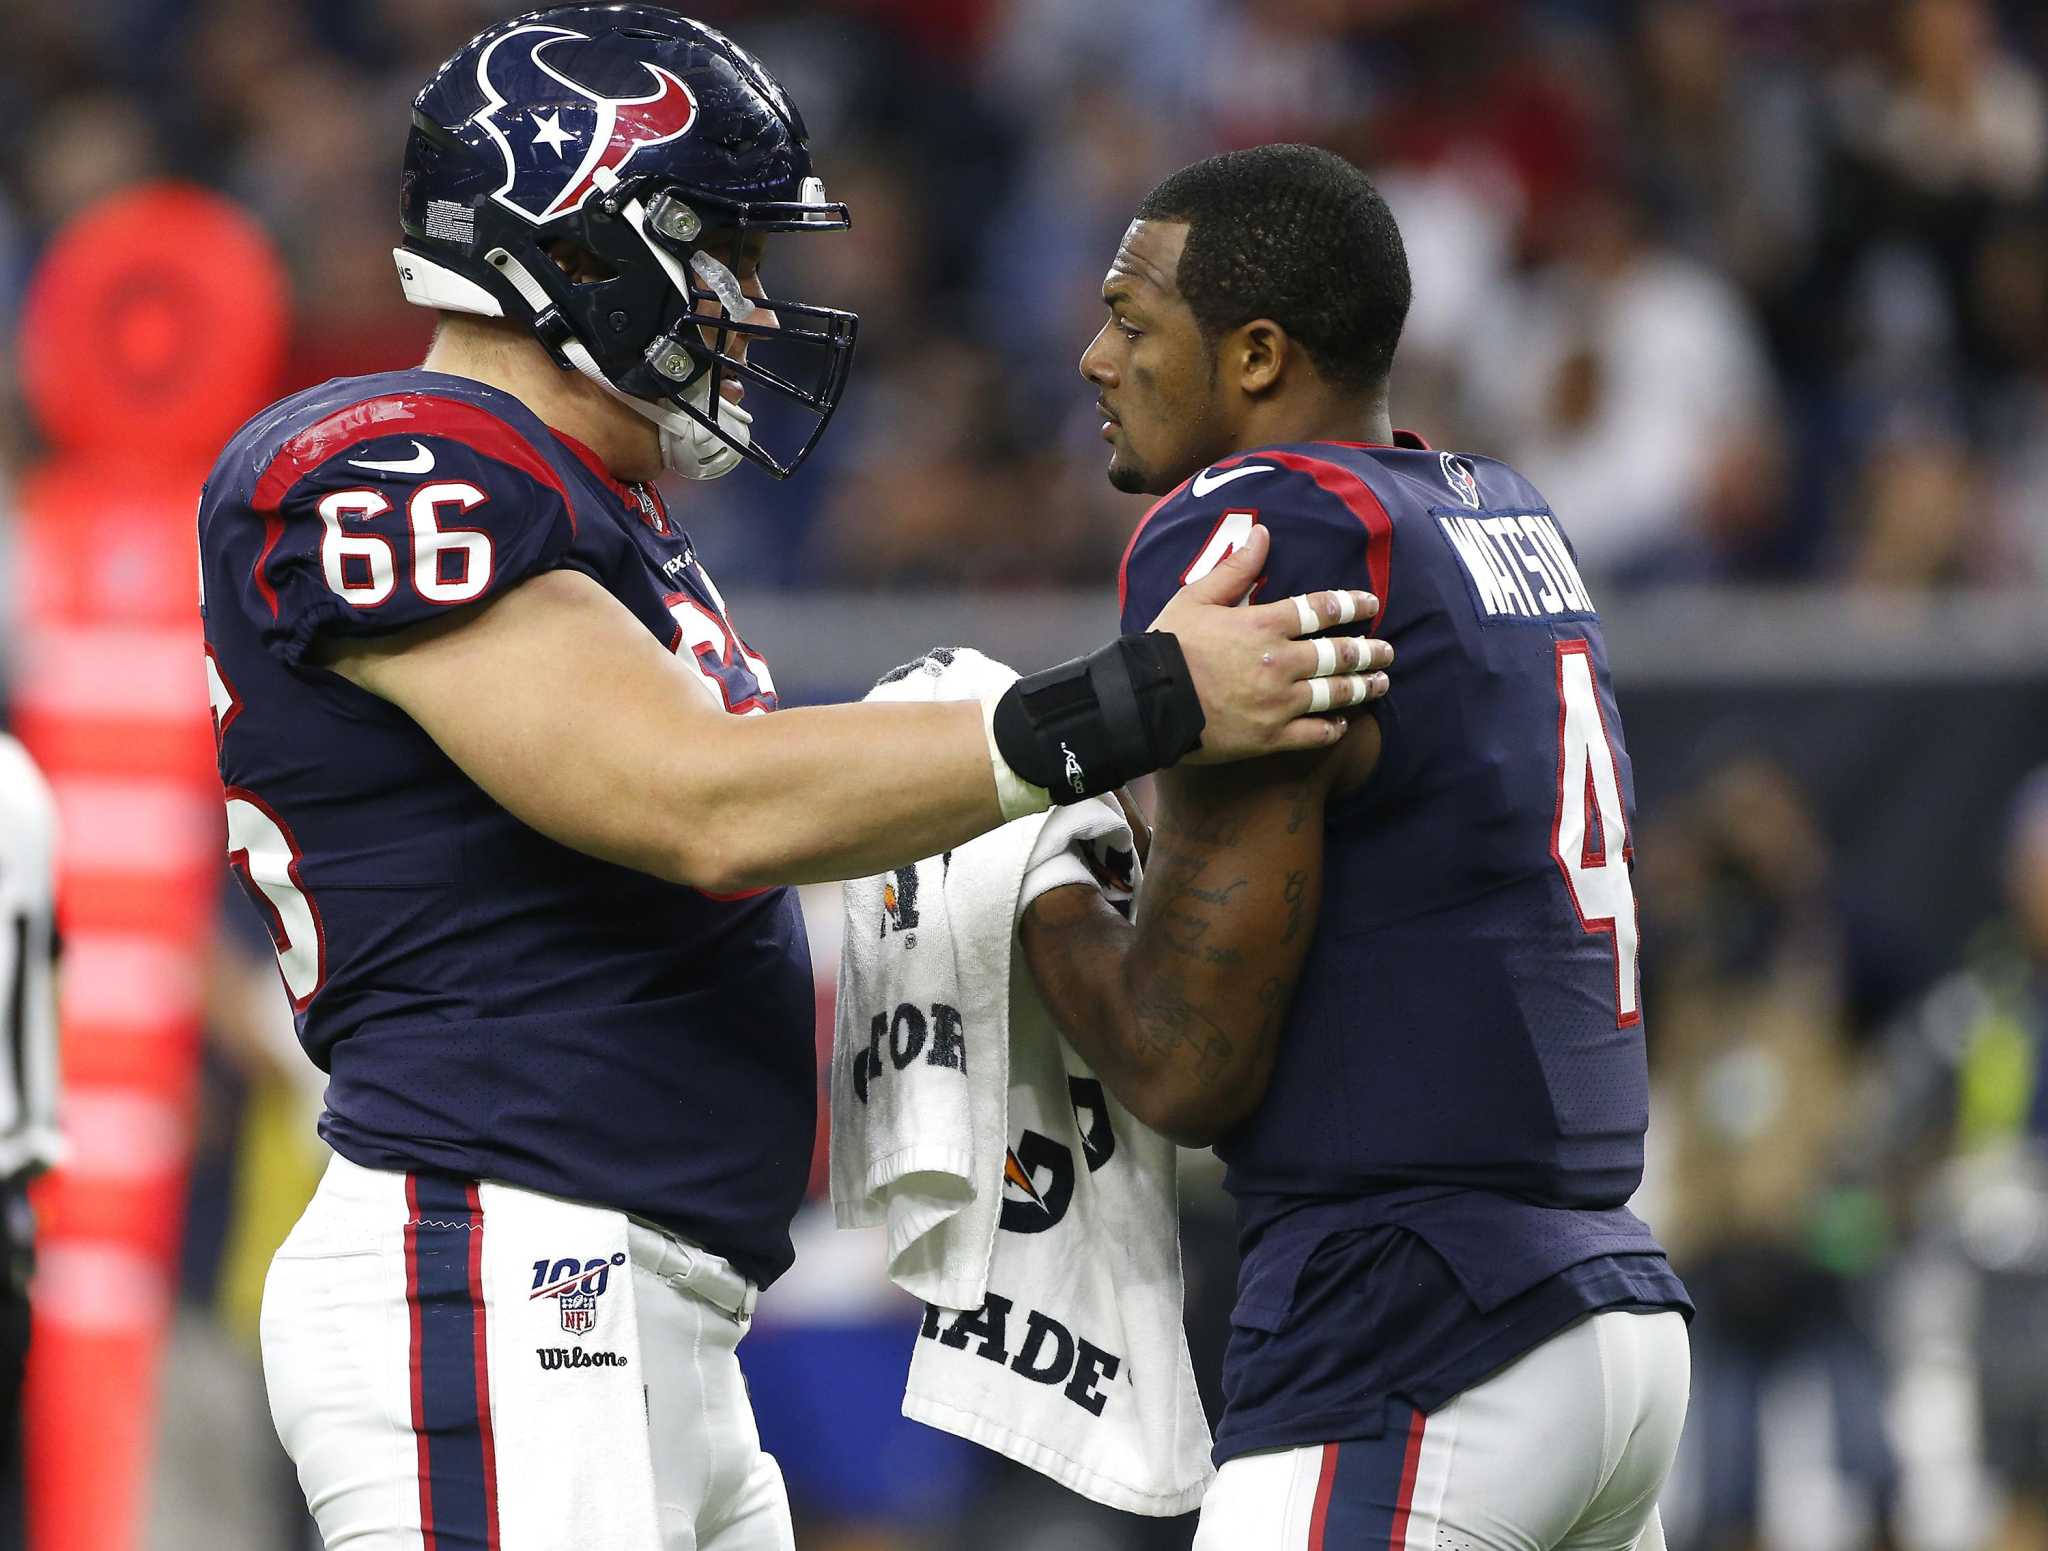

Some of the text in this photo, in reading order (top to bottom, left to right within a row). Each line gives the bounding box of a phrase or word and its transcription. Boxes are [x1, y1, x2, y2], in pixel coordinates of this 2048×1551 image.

[318, 480, 495, 608] 66
[1438, 515, 1597, 617] WATSON
[1549, 638, 1641, 1030] 4
[535, 1346, 618, 1370] Wilson
[564, 1310, 593, 1331] NFL
[921, 1292, 1121, 1418] ADE
